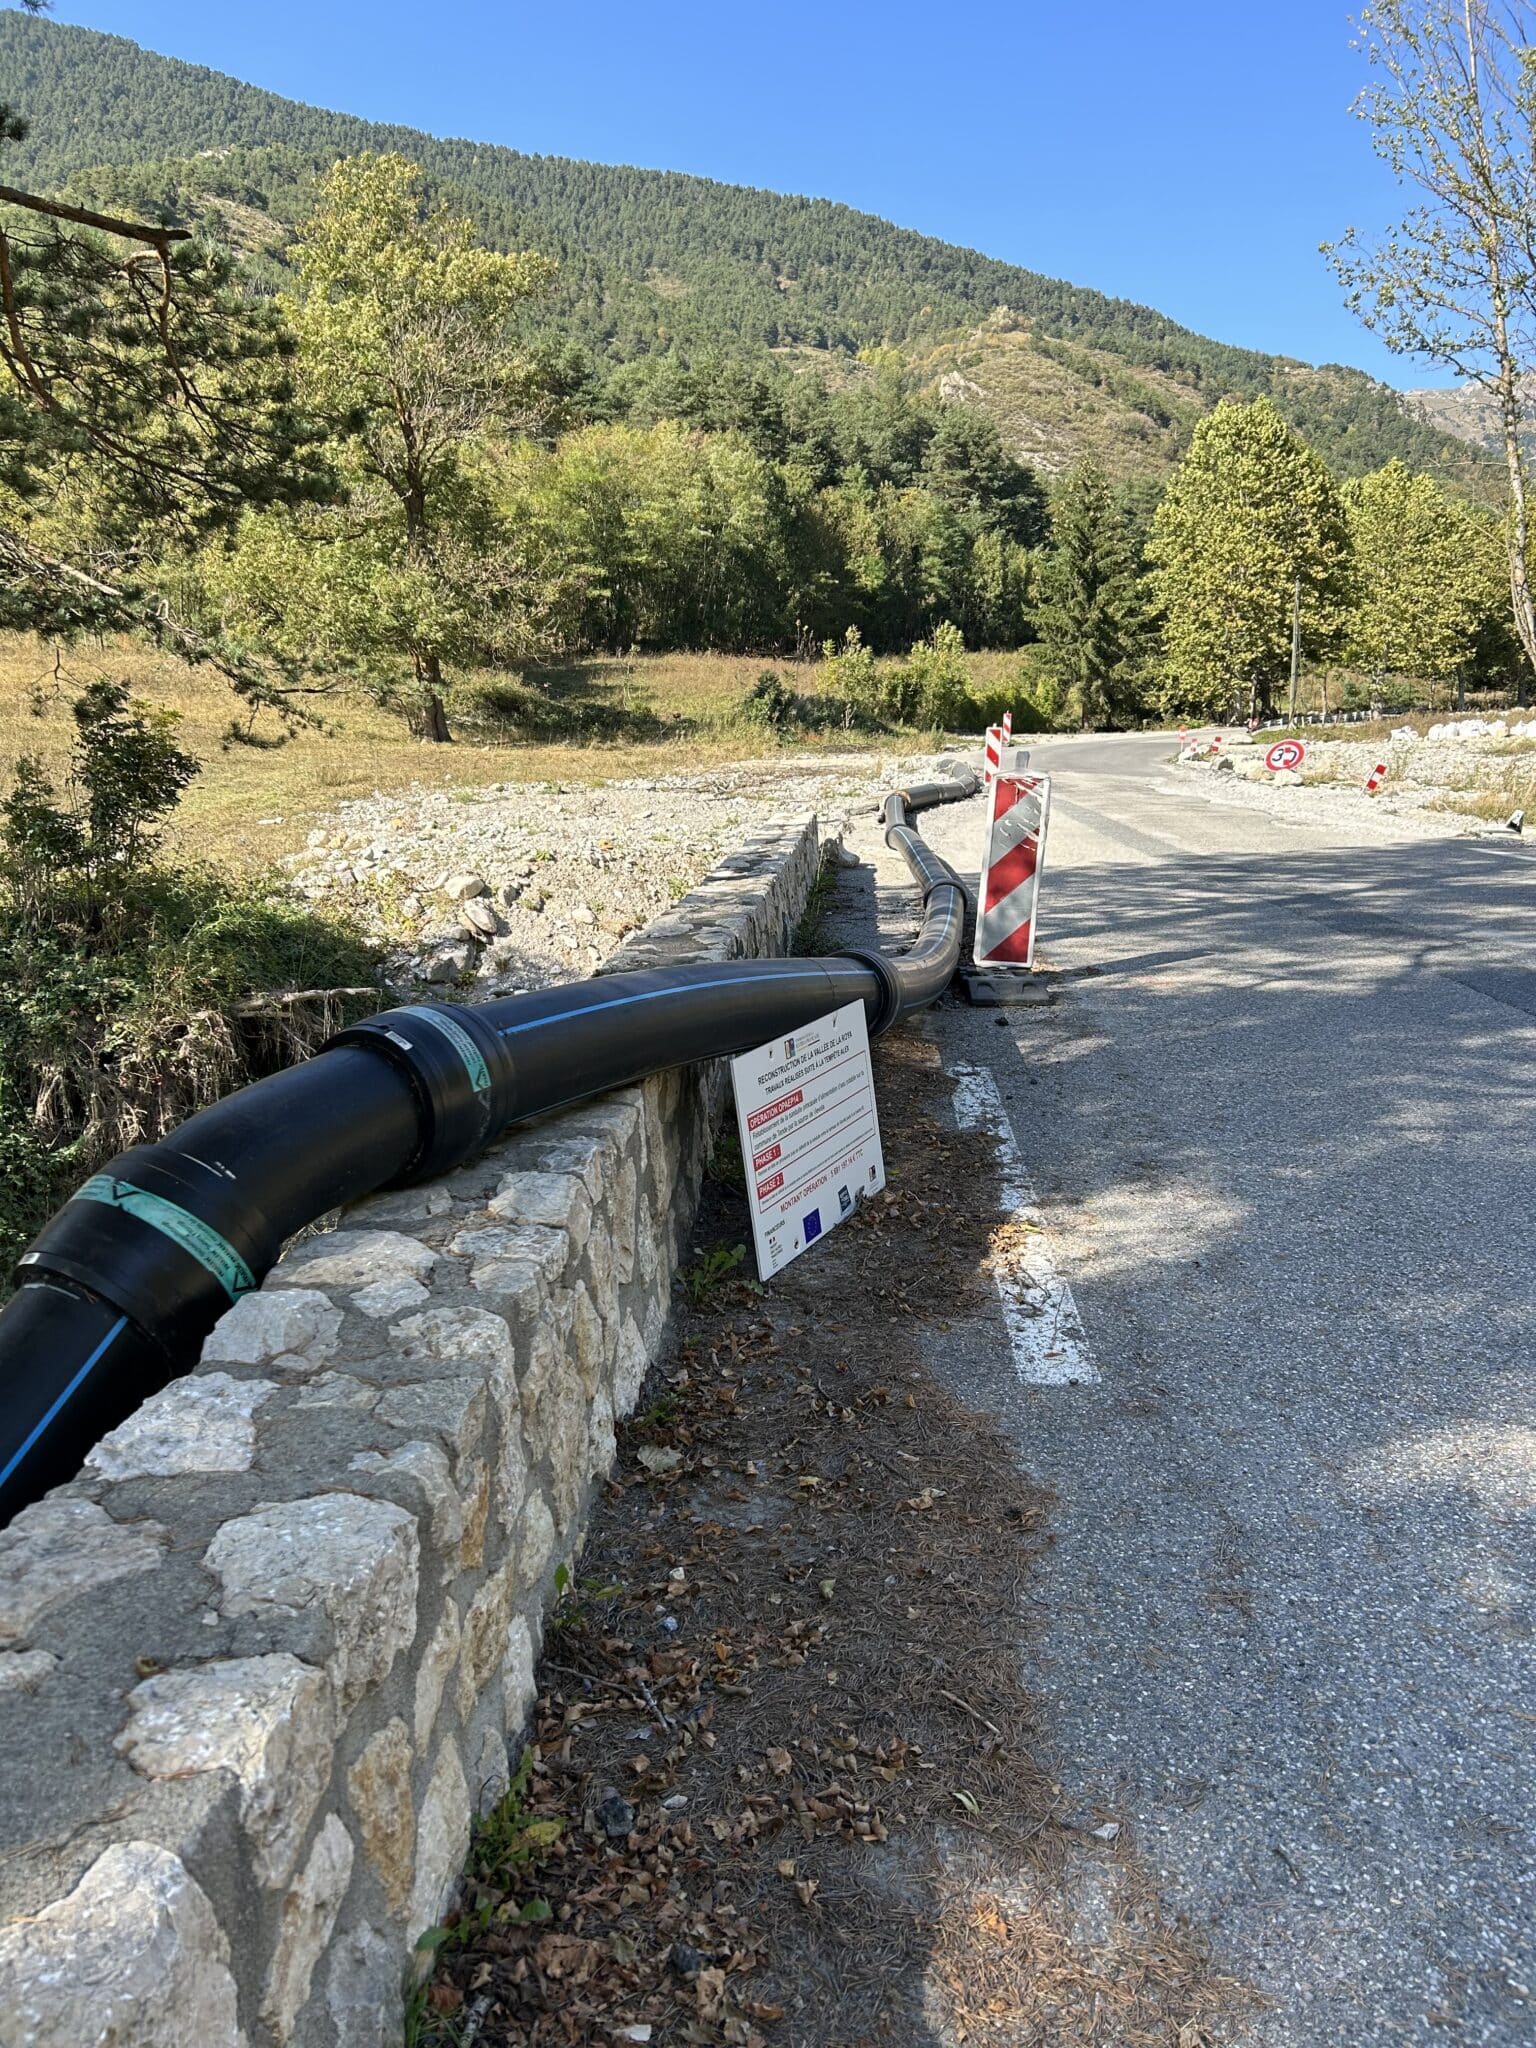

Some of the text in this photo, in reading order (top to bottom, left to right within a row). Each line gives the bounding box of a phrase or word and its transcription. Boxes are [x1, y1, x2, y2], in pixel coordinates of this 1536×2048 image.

[758, 1058, 801, 1085] RECONSTRUCTION
[801, 1054, 808, 1063] DE
[808, 1051, 814, 1060] LA
[830, 1040, 836, 1048] DE
[836, 1036, 842, 1045] LA
[842, 1031, 853, 1042] ROYA
[765, 1080, 785, 1096] TRAVAUX
[804, 1063, 816, 1075] SUITE
[819, 1058, 825, 1066] LA
[840, 1045, 850, 1055] ALEX
[756, 1150, 774, 1168] PHASE
[773, 1148, 777, 1157] 1
[760, 1178, 777, 1197] PHASE
[776, 1176, 781, 1185] 2
[781, 1191, 803, 1213] MONTANT
